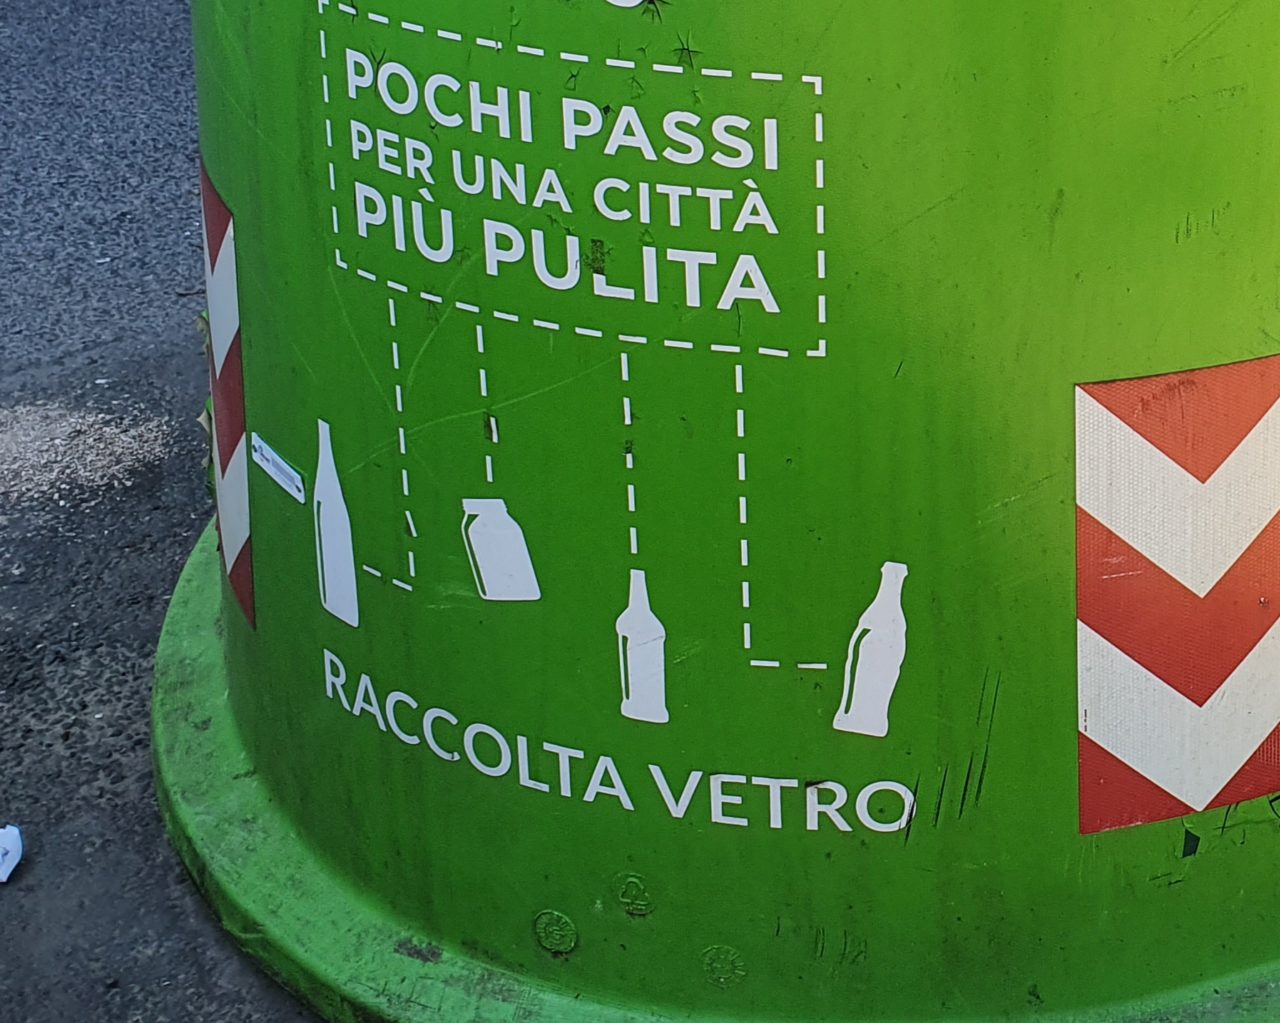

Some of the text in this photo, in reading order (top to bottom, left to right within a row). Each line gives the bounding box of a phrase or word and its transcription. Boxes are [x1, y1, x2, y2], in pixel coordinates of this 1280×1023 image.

[346, 47, 779, 172] POCHI PASSI
[350, 119, 779, 235] PER UNA CITTÀ
[354, 181, 781, 314] PIÙ PULITA
[323, 648, 917, 834] RACCOLTA VETRO
